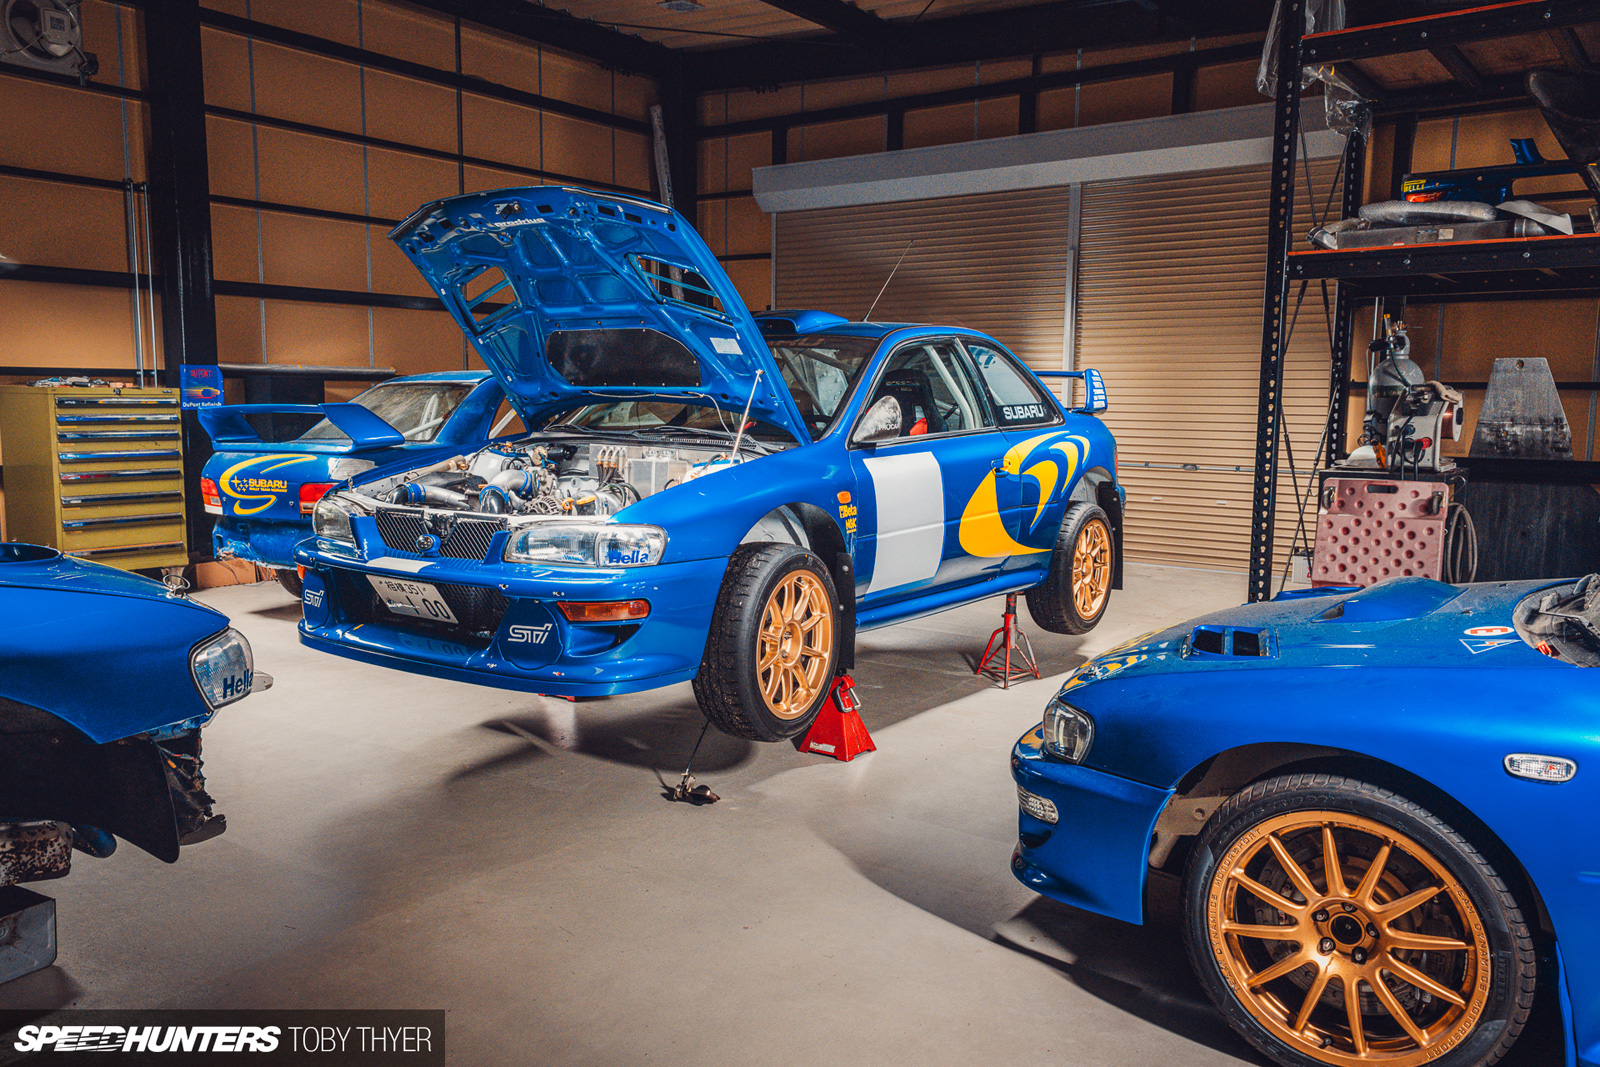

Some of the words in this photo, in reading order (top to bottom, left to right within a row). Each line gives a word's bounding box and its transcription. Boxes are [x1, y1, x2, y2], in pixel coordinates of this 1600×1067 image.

[1002, 404, 1045, 420] SUBARU
[248, 478, 288, 489] SUBARU
[608, 550, 650, 565] Hella
[222, 668, 254, 700] Hella
[1213, 828, 1261, 888] MOTORSPORT
[1451, 881, 1476, 915] TEAM
[1209, 894, 1223, 955] DYNAMICS
[1473, 922, 1490, 993] DYNAMICS
[1425, 998, 1483, 1061] MOTORSPORT
